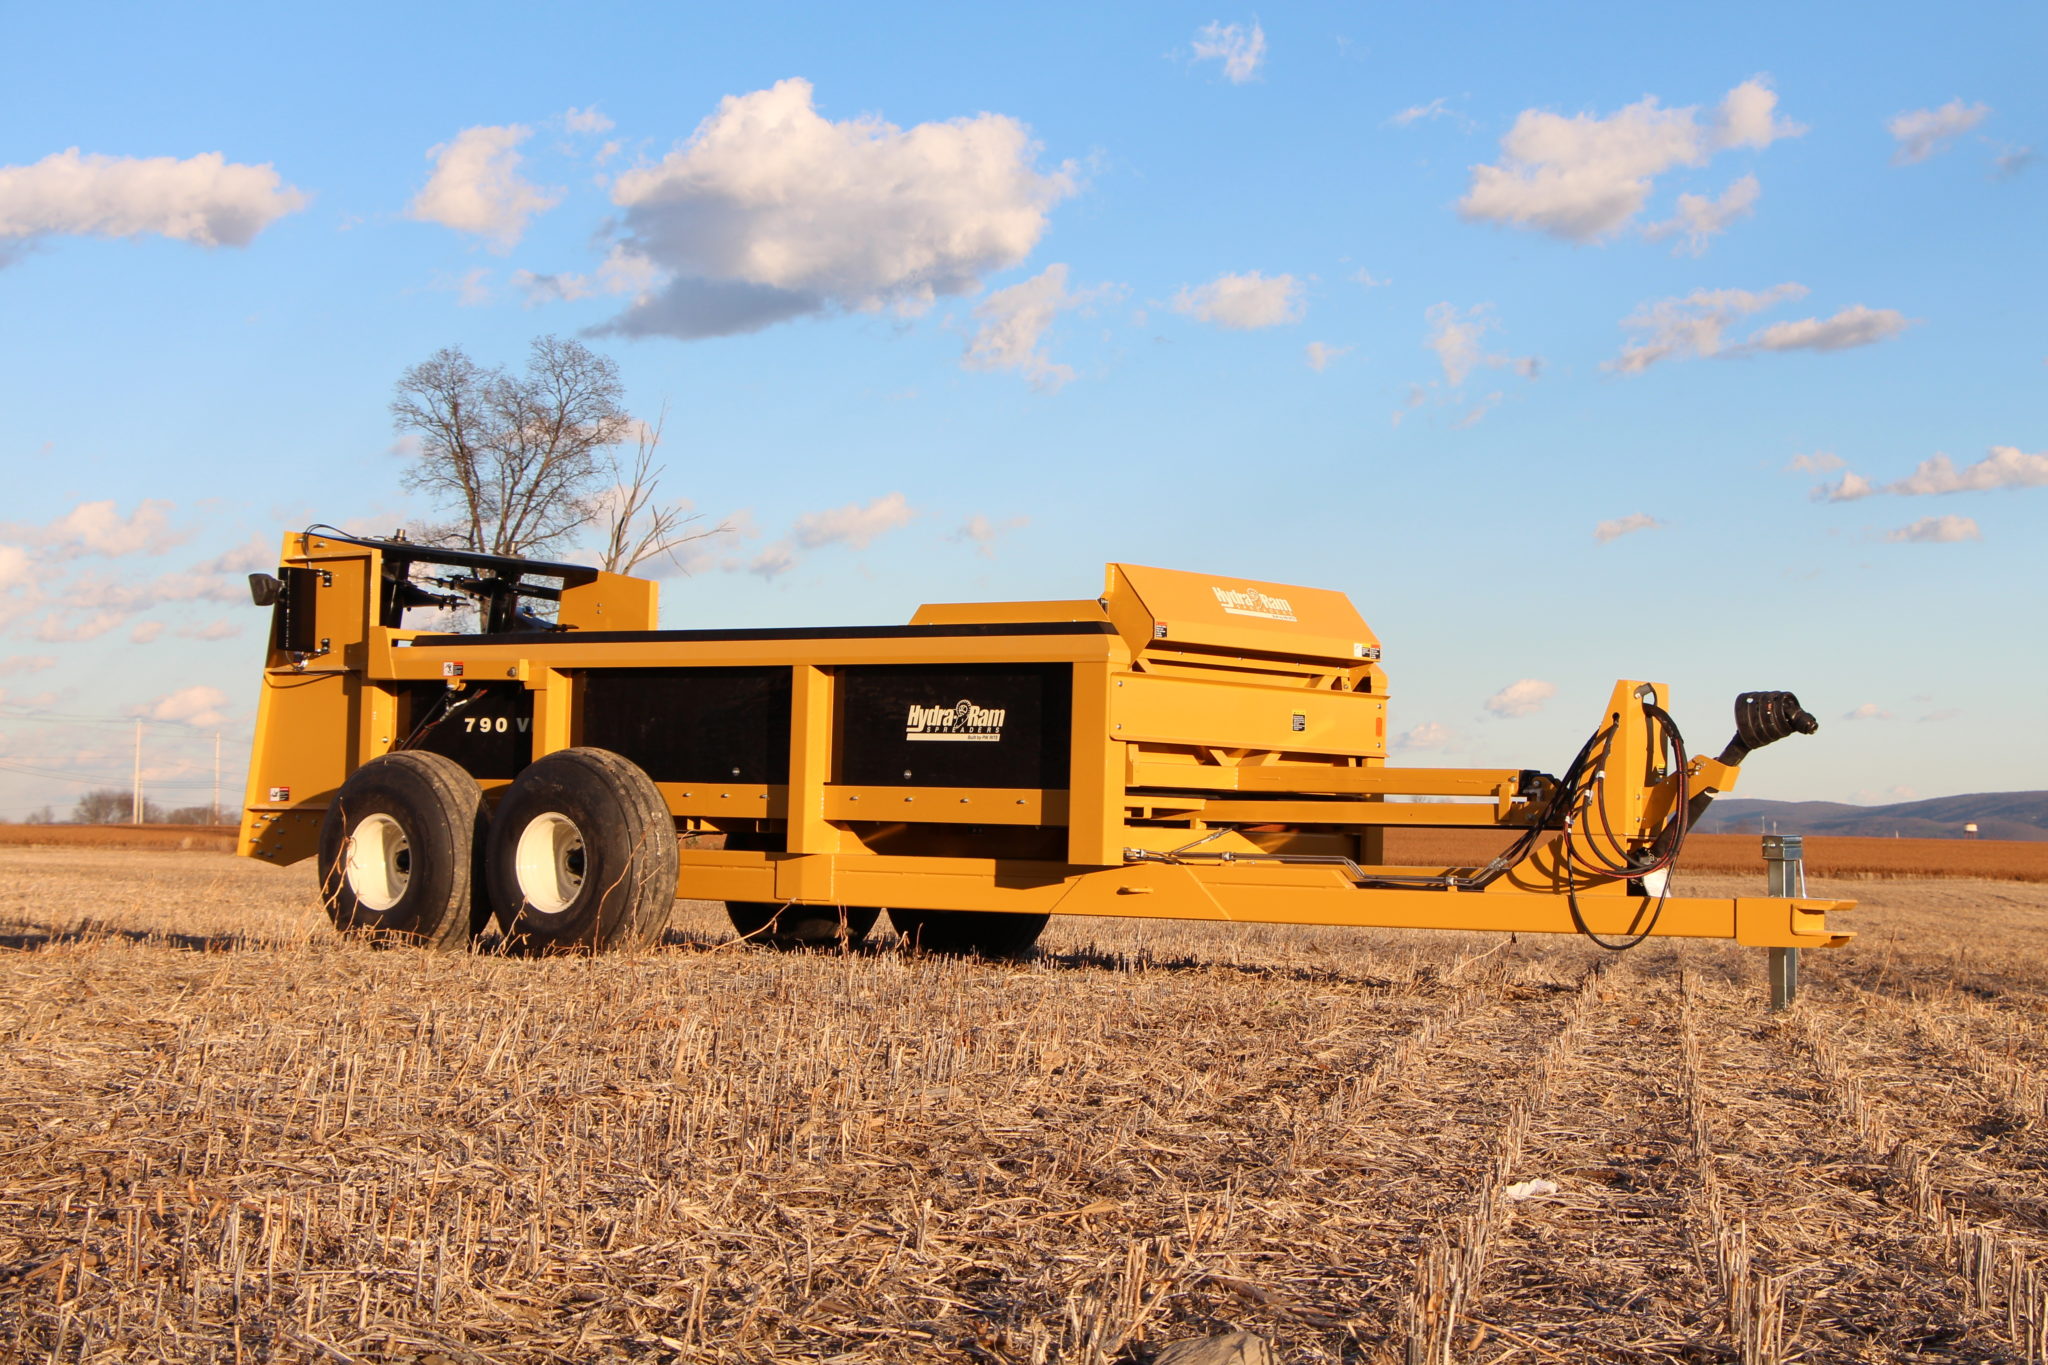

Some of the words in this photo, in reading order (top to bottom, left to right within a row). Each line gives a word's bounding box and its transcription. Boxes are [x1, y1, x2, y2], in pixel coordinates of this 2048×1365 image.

[1259, 593, 1293, 612] Ram
[464, 717, 508, 733] 790
[967, 705, 1005, 727] Ram
